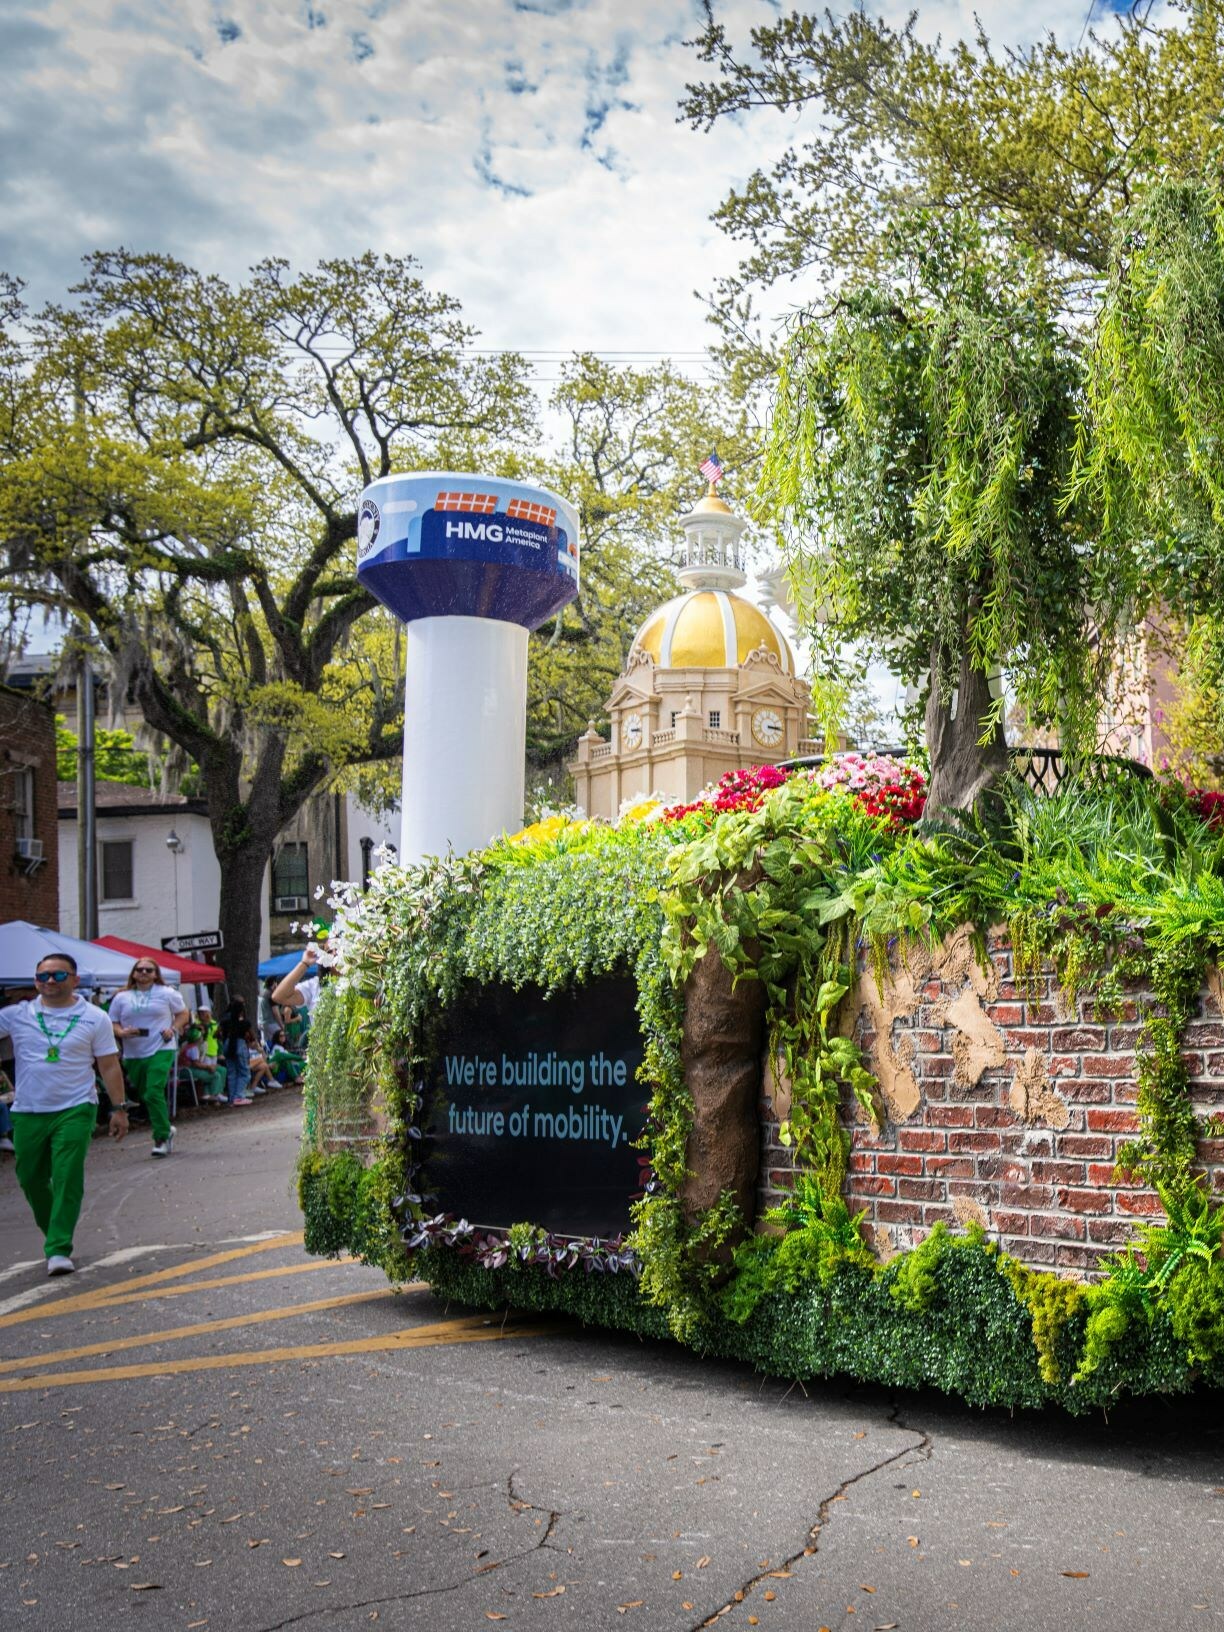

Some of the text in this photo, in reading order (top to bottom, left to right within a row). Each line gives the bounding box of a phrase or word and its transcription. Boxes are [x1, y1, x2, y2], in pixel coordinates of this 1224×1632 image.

[445, 521, 503, 542] HMG
[505, 526, 548, 543] Metaplant
[505, 535, 540, 550] America
[179, 936, 215, 948] ONE WAY
[445, 1052, 627, 1094] We're building the
[449, 1102, 628, 1149] future of mobility.
